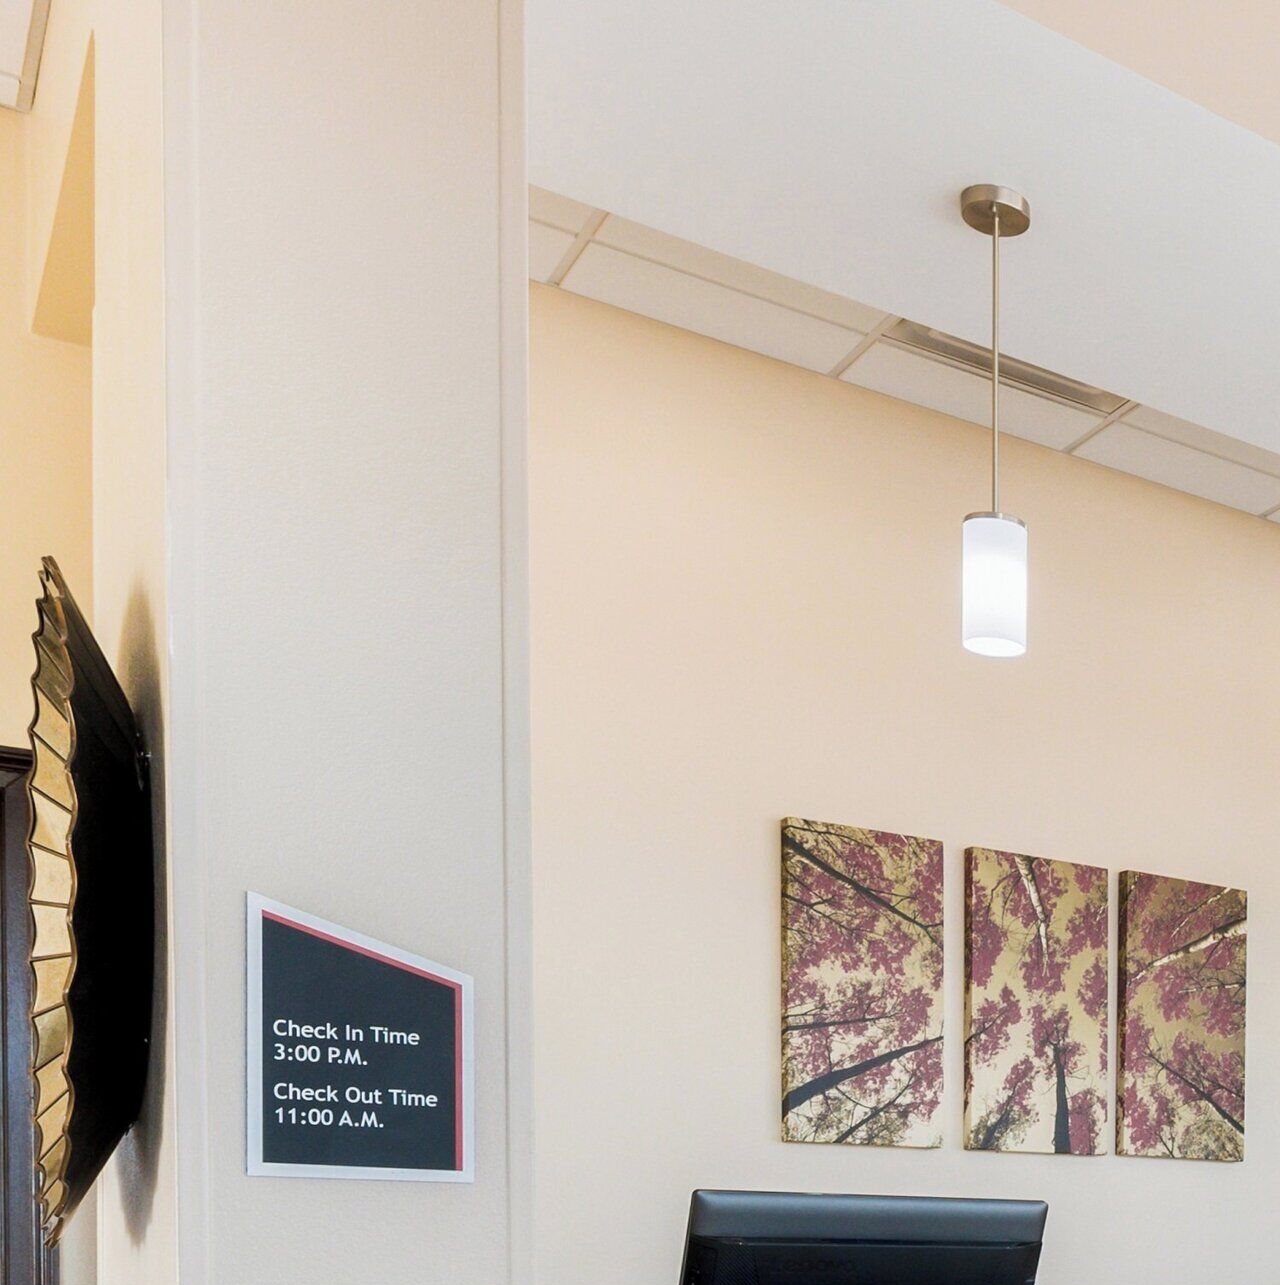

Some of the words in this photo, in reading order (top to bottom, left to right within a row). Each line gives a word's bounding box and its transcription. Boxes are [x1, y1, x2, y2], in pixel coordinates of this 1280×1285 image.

[272, 1019, 338, 1041] Check
[345, 1024, 364, 1042] In
[370, 1026, 420, 1046] Time
[273, 1044, 320, 1063] 3:00
[328, 1047, 368, 1065] P.M.
[273, 1082, 339, 1103] Check
[345, 1086, 382, 1104] Out
[388, 1088, 438, 1108] Time
[274, 1107, 333, 1126] 11:00
[338, 1111, 384, 1128] A.M.
